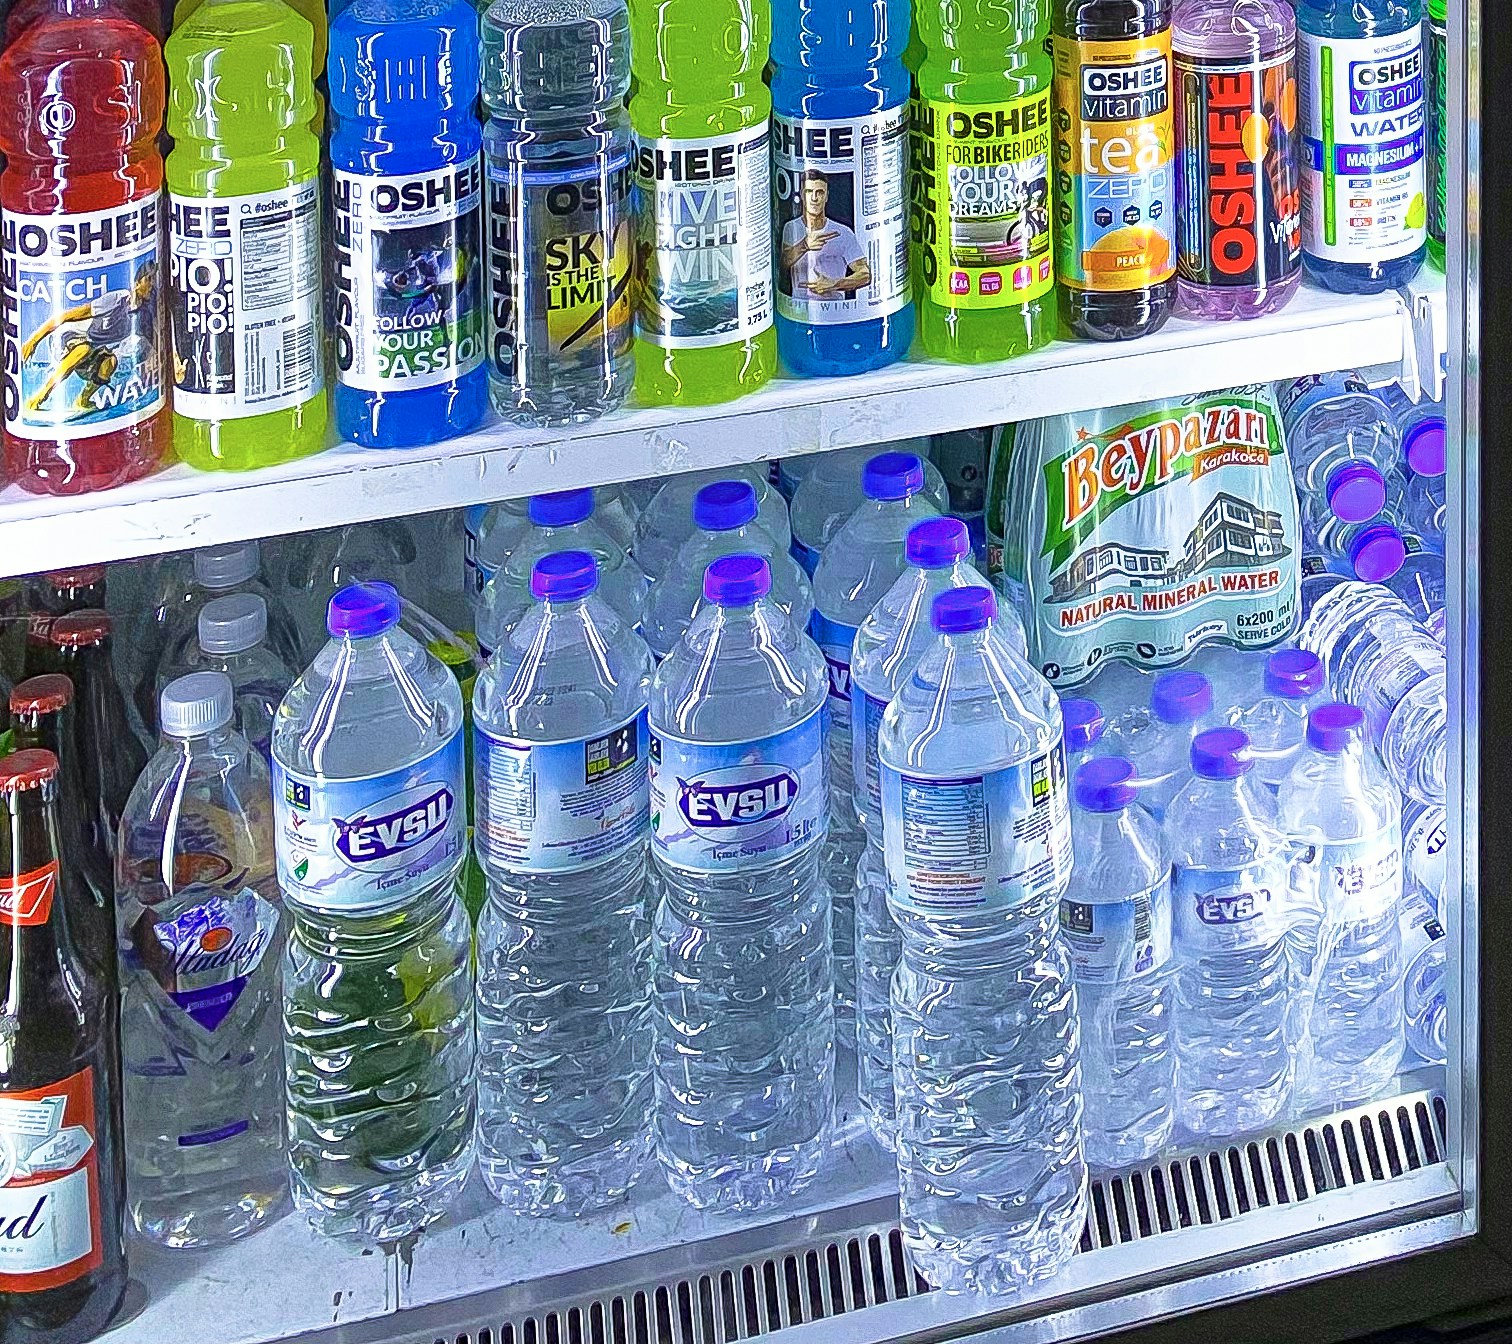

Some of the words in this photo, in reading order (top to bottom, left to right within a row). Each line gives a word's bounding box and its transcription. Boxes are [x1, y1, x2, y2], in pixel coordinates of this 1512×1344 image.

[1088, 65, 1163, 91] OSHEE
[1358, 52, 1420, 85] OSHEE
[946, 99, 1048, 139] OSHEE
[1084, 89, 1167, 118] vitamin
[1081, 127, 1159, 173] tea
[1347, 146, 1413, 167] MAGNESIUM
[371, 164, 481, 213] OSHEE
[1208, 72, 1256, 275] OSHEE
[254, 199, 289, 213] #oshee
[922, 105, 937, 287] OSHEE
[19, 202, 157, 257] OSHEE
[335, 178, 353, 372] OSHEE
[566, 265, 600, 284] THE
[187, 293, 233, 313] PIO!
[547, 274, 616, 311] LIMIT
[187, 312, 233, 334] PIO!
[374, 332, 434, 352] YOUR
[1061, 593, 1141, 627] NATURAL
[1142, 577, 1217, 611] MINERAL
[1221, 571, 1279, 591] WATER
[1236, 612, 1274, 627] 6x200
[1238, 626, 1270, 641] SERVE
[1271, 615, 1291, 635] COLD
[686, 777, 792, 819] EVSU
[349, 793, 449, 857] EVSU
